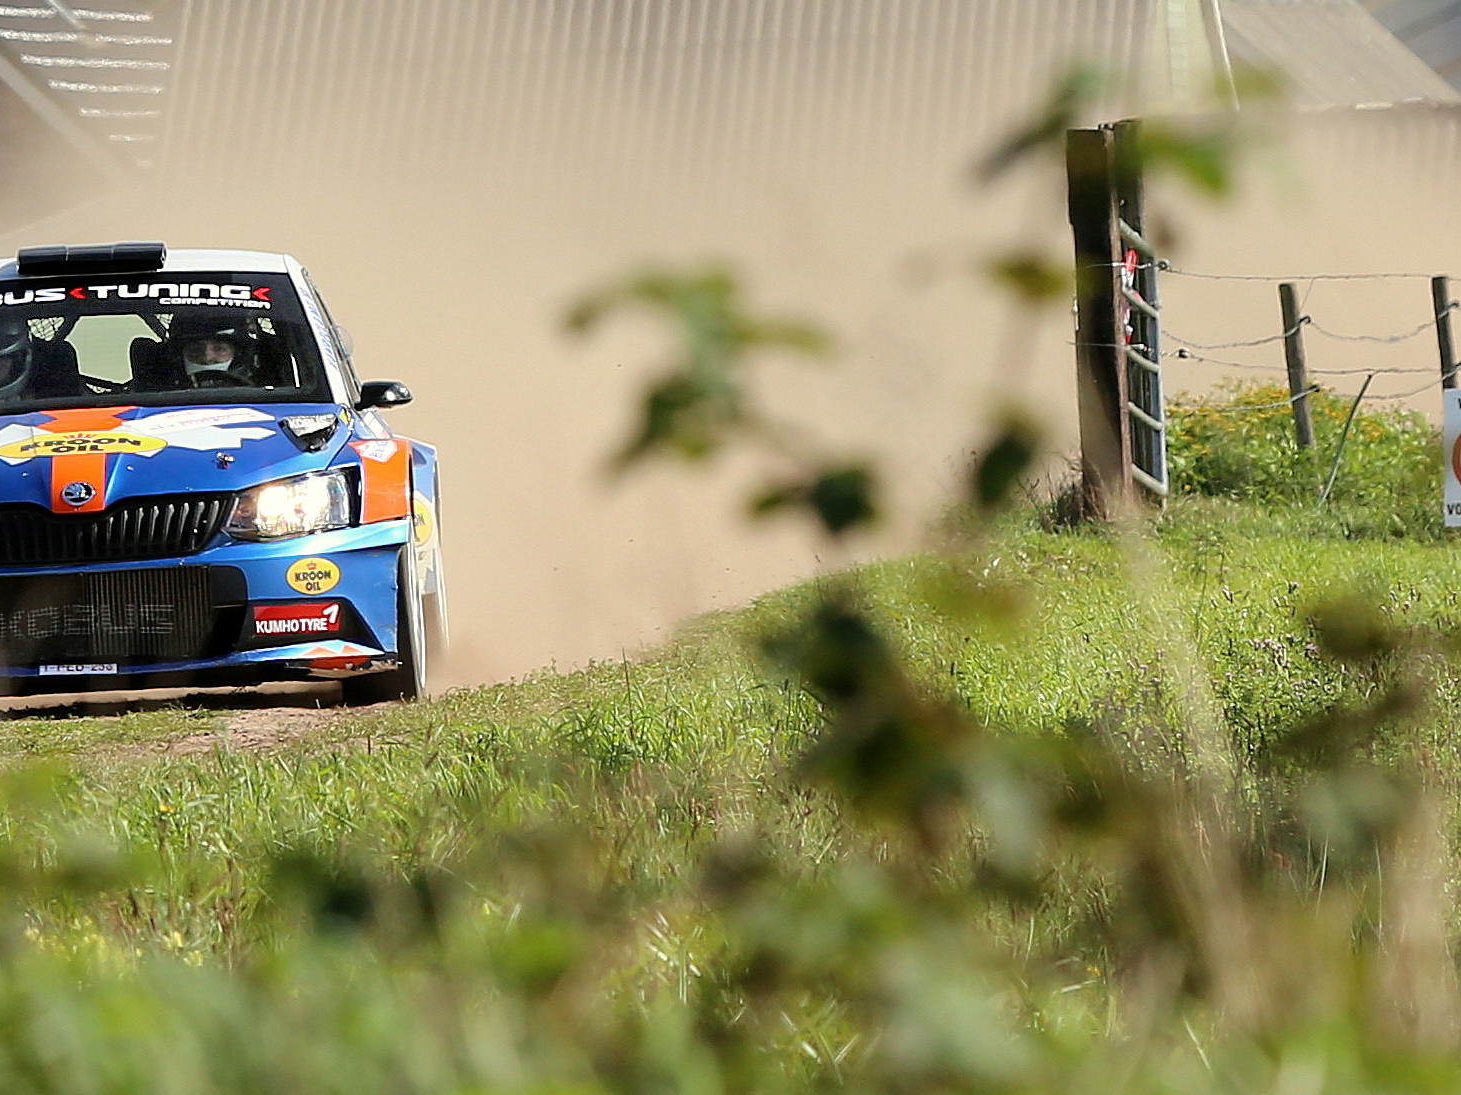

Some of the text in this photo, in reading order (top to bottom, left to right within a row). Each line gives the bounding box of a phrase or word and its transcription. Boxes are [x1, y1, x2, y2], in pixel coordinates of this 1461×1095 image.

[87, 284, 252, 299] TUNING
[159, 297, 272, 310] COMPETITION
[20, 438, 141, 452] KROON
[51, 445, 104, 453] OIL
[294, 570, 332, 582] KROON
[305, 582, 321, 592] OIL
[255, 617, 328, 634] KUMHO TYRE
